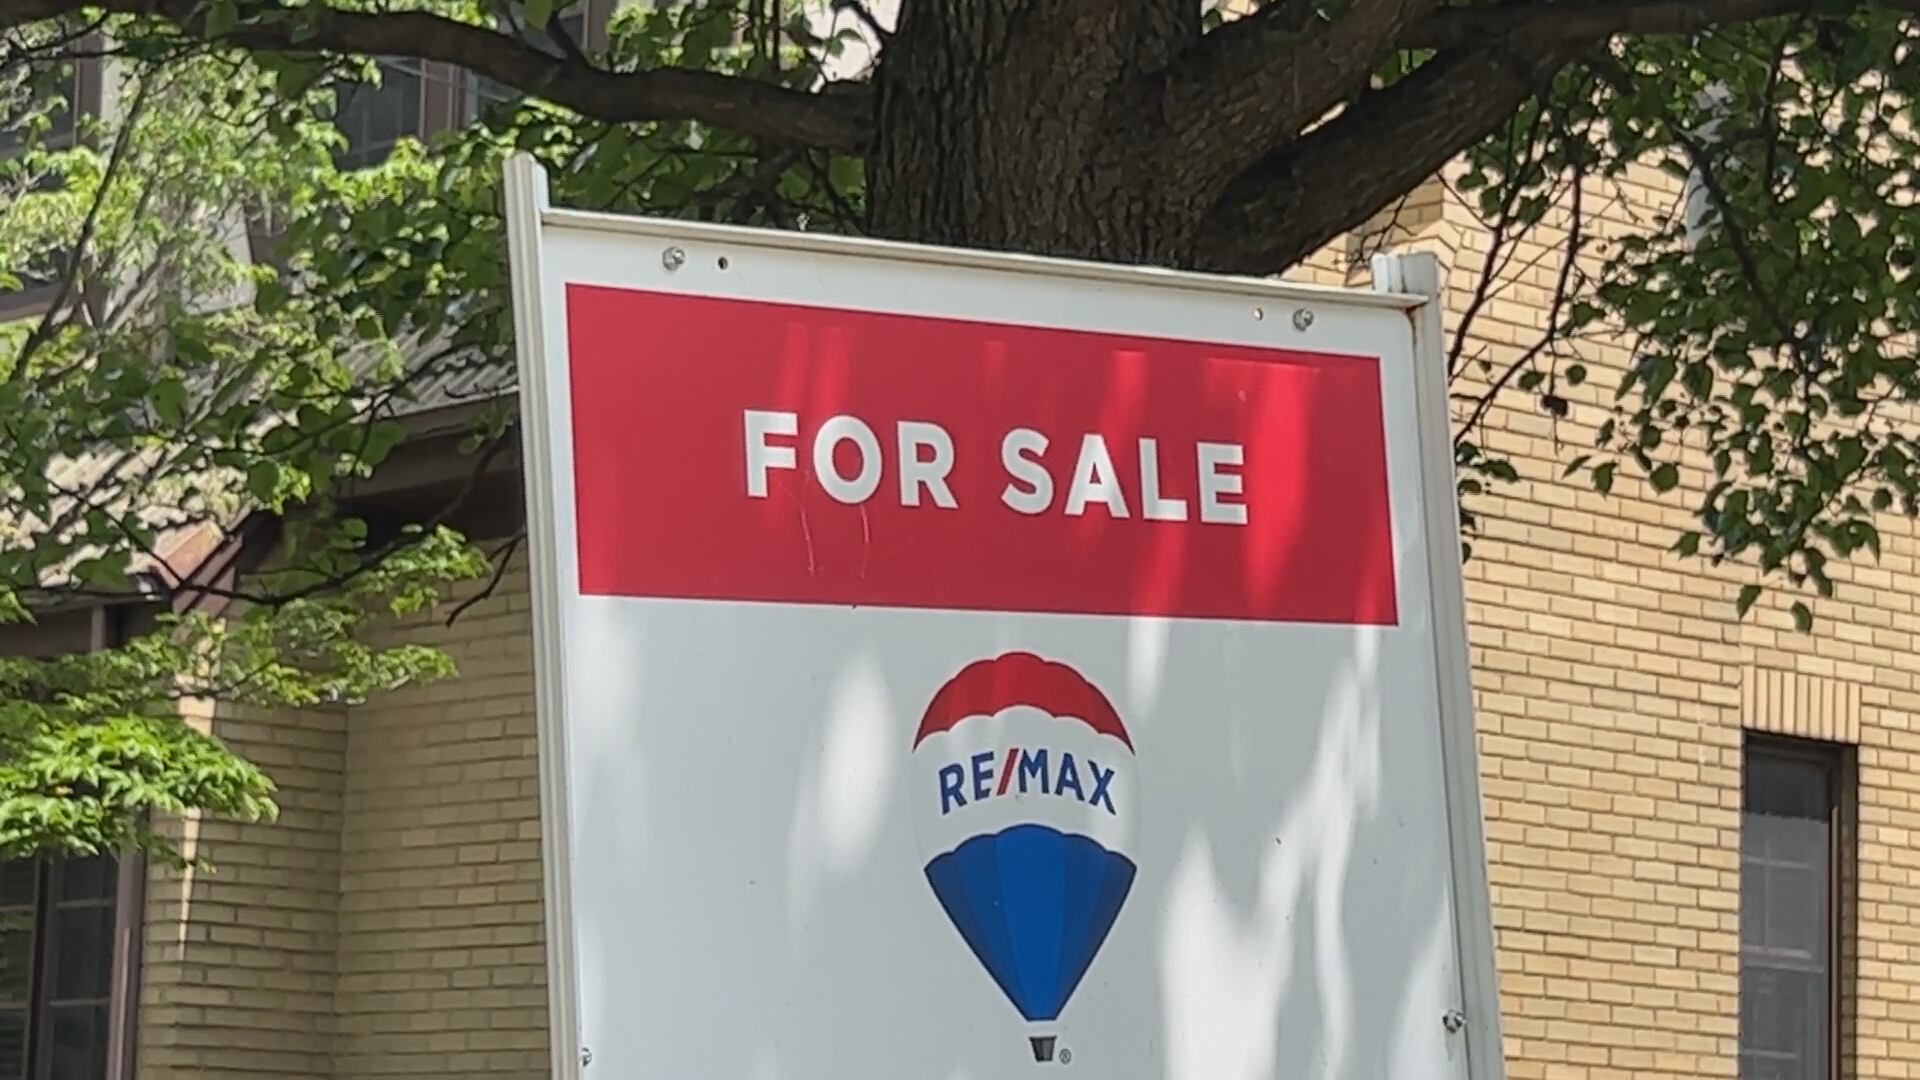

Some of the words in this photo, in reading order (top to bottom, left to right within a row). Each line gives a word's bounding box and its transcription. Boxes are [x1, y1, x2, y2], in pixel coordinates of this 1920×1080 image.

[744, 409, 958, 508] FOR
[1001, 428, 1248, 524] SALE
[938, 747, 1117, 816] RE/MAX
